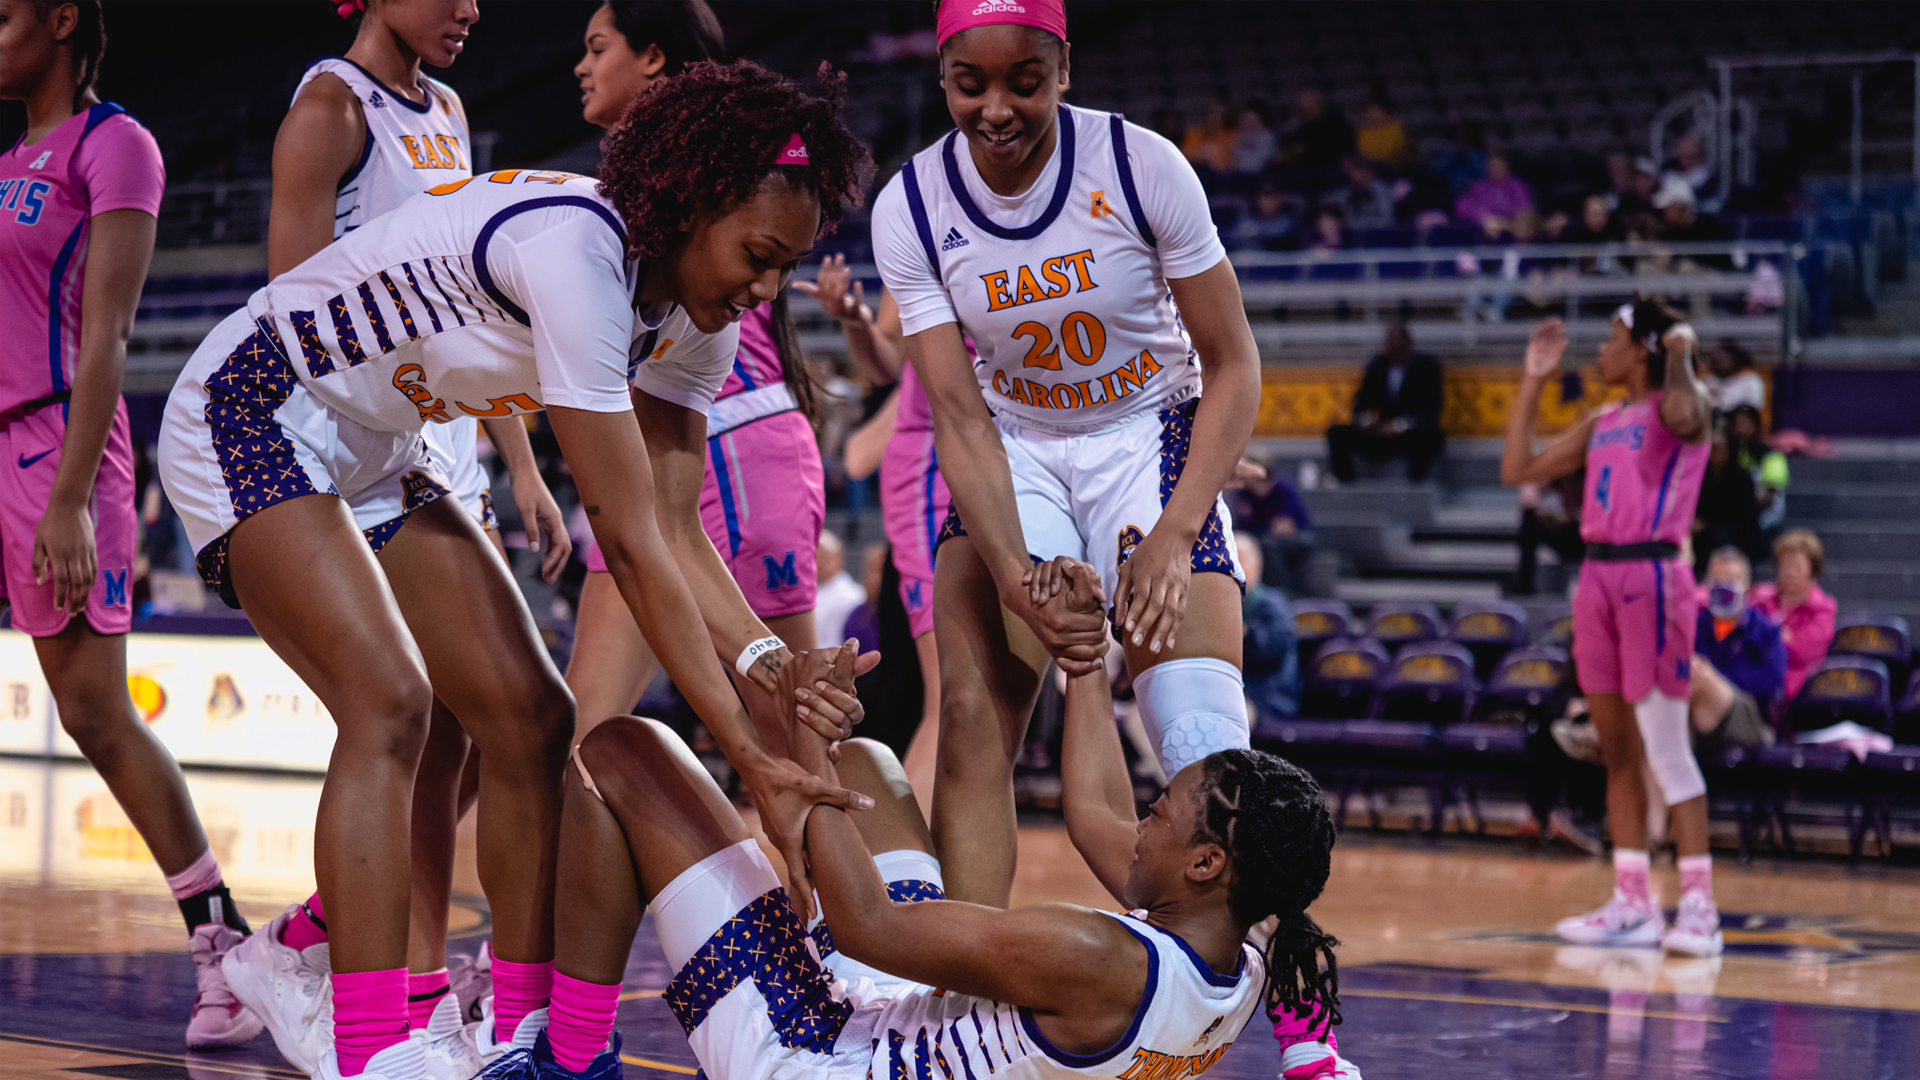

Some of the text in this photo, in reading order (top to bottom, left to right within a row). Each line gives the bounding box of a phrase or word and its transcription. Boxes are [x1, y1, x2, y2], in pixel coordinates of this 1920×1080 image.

[972, 4, 1026, 16] adidas
[398, 133, 468, 171] EAST
[941, 238, 970, 251] adidas
[979, 249, 1099, 312] EAST
[1011, 311, 1106, 371] 20
[992, 349, 1164, 410] CAROLINA
[410, 478, 427, 491] ECU
[1595, 466, 1612, 511] 4
[1122, 533, 1135, 547] ECU
[103, 569, 127, 606] M
[763, 551, 799, 590] M
[749, 643, 765, 655] 40
